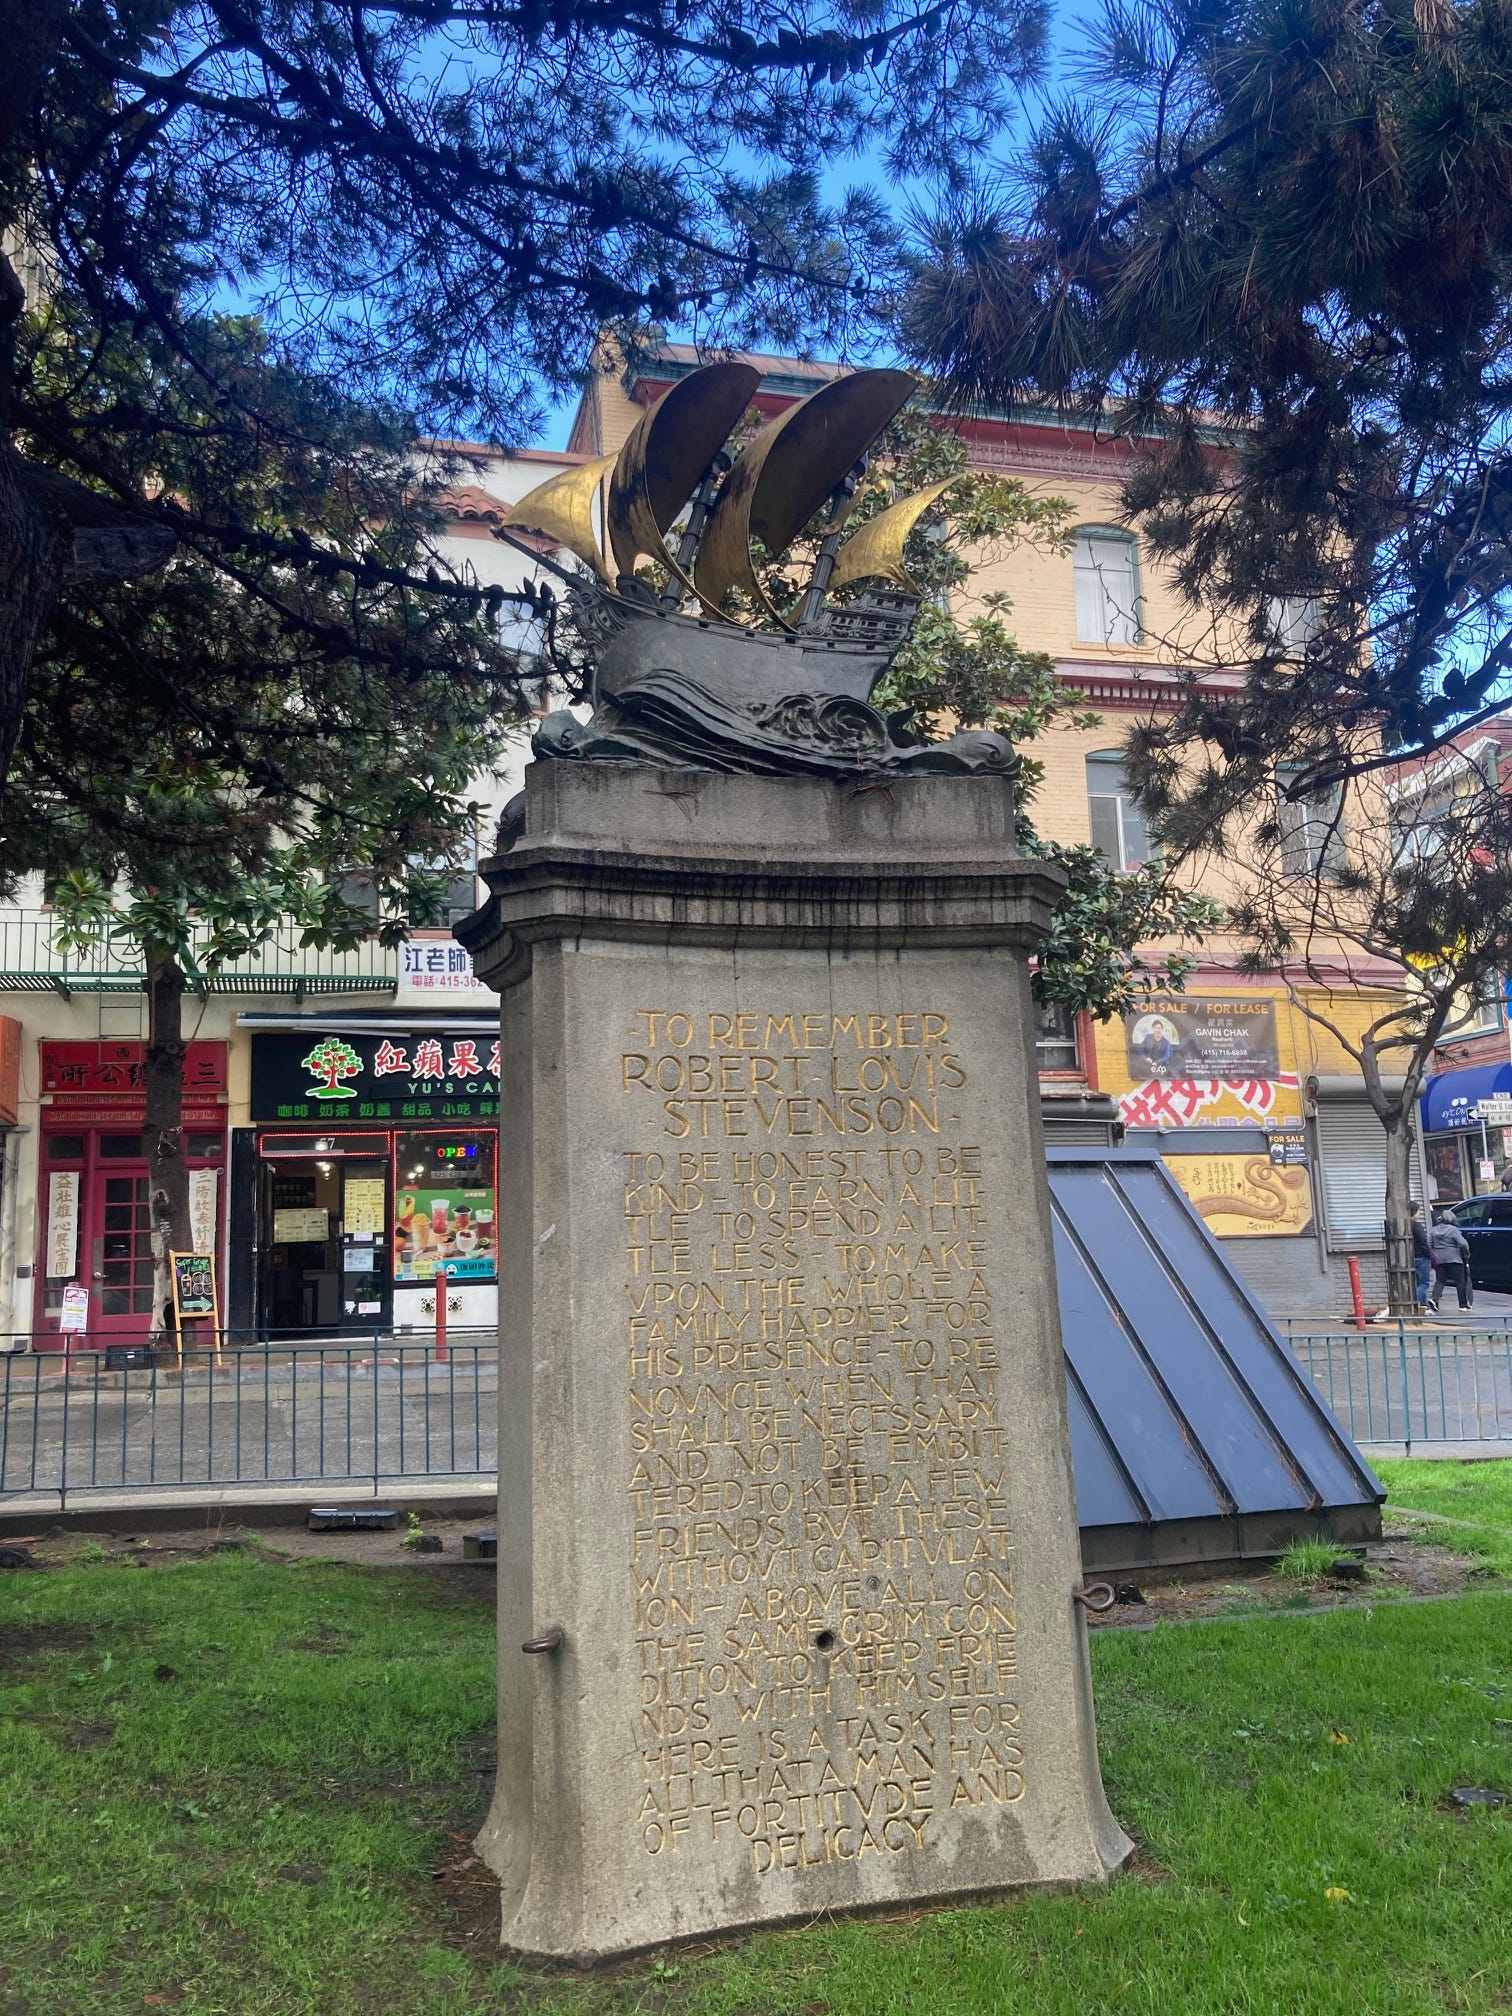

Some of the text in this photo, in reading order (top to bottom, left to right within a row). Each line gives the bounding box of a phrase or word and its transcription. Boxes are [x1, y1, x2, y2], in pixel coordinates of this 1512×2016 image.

[405, 947, 473, 972] 江老師
[1159, 1003, 1187, 1013] SALE
[1206, 1004, 1230, 1014] FOR
[1234, 1004, 1268, 1014] LEASE
[637, 1010, 950, 1050] TO REMEMBER
[1195, 1028, 1249, 1037] GAVIN CHAK
[408, 1081, 500, 1094] YU'S CA
[622, 1053, 967, 1095] ROBERT LOVIS
[277, 1104, 309, 1118] 咖啡
[319, 1103, 350, 1118] 奶茶
[402, 1102, 432, 1116] 甜品
[441, 1102, 472, 1115] 小吃
[664, 1096, 940, 1138] STEVENSON
[437, 1144, 477, 1157] OPEN
[1285, 1135, 1305, 1143] SALE
[625, 1147, 982, 1182] TO BE HONEST TO BE
[625, 1183, 703, 1212] KIND
[733, 1182, 775, 1210] TO
[788, 1179, 886, 1209] EARN
[900, 1179, 922, 1207] A
[625, 1213, 689, 1242] TLE
[713, 1213, 755, 1241] TO
[768, 1210, 880, 1239] SPEND
[894, 1208, 917, 1234] A
[626, 1245, 691, 1275] TLE
[712, 1242, 800, 1273] LESS
[834, 1245, 876, 1272] TO
[885, 1241, 987, 1272] MAKE
[625, 1273, 993, 1312] VPON THE WHOLE A
[629, 1303, 992, 1347] FAMILY HAPPIER FOR
[630, 1346, 683, 1379] HIS
[693, 1337, 873, 1375] PRESENCE
[892, 1339, 936, 1368] TO
[629, 1365, 1000, 1418] NOVNCE WHEN THAT
[630, 1399, 998, 1453] SHALL BE NECESSARY
[629, 1450, 710, 1487] AND
[732, 1441, 802, 1477] NOT
[821, 1437, 865, 1470] BE
[751, 1482, 793, 1514] TO
[802, 1474, 891, 1511] KEEP
[896, 1474, 920, 1503] A
[928, 1467, 1004, 1500] FEW
[634, 1498, 1008, 1561] FRIENDS BVT THESE
[630, 1546, 801, 1594] WITHOVT
[637, 1595, 695, 1631] ION
[735, 1579, 860, 1625] ABOVE
[878, 1574, 950, 1609] ALL
[963, 1568, 1014, 1601] ON
[634, 1601, 1016, 1673] THE SAME GRIM CON
[641, 1662, 756, 1706] DITION
[767, 1653, 812, 1685] TO
[829, 1640, 924, 1679] KEEP
[641, 1664, 1018, 1740] NDS WITH HIMSELF
[642, 1702, 1021, 1782] HERE IS A TASK FOR
[636, 1735, 1025, 1823] ALL THAT A MAN HAS
[643, 1770, 1026, 1855] OF FORTITVDE AND
[752, 1813, 932, 1875] DELICACY
